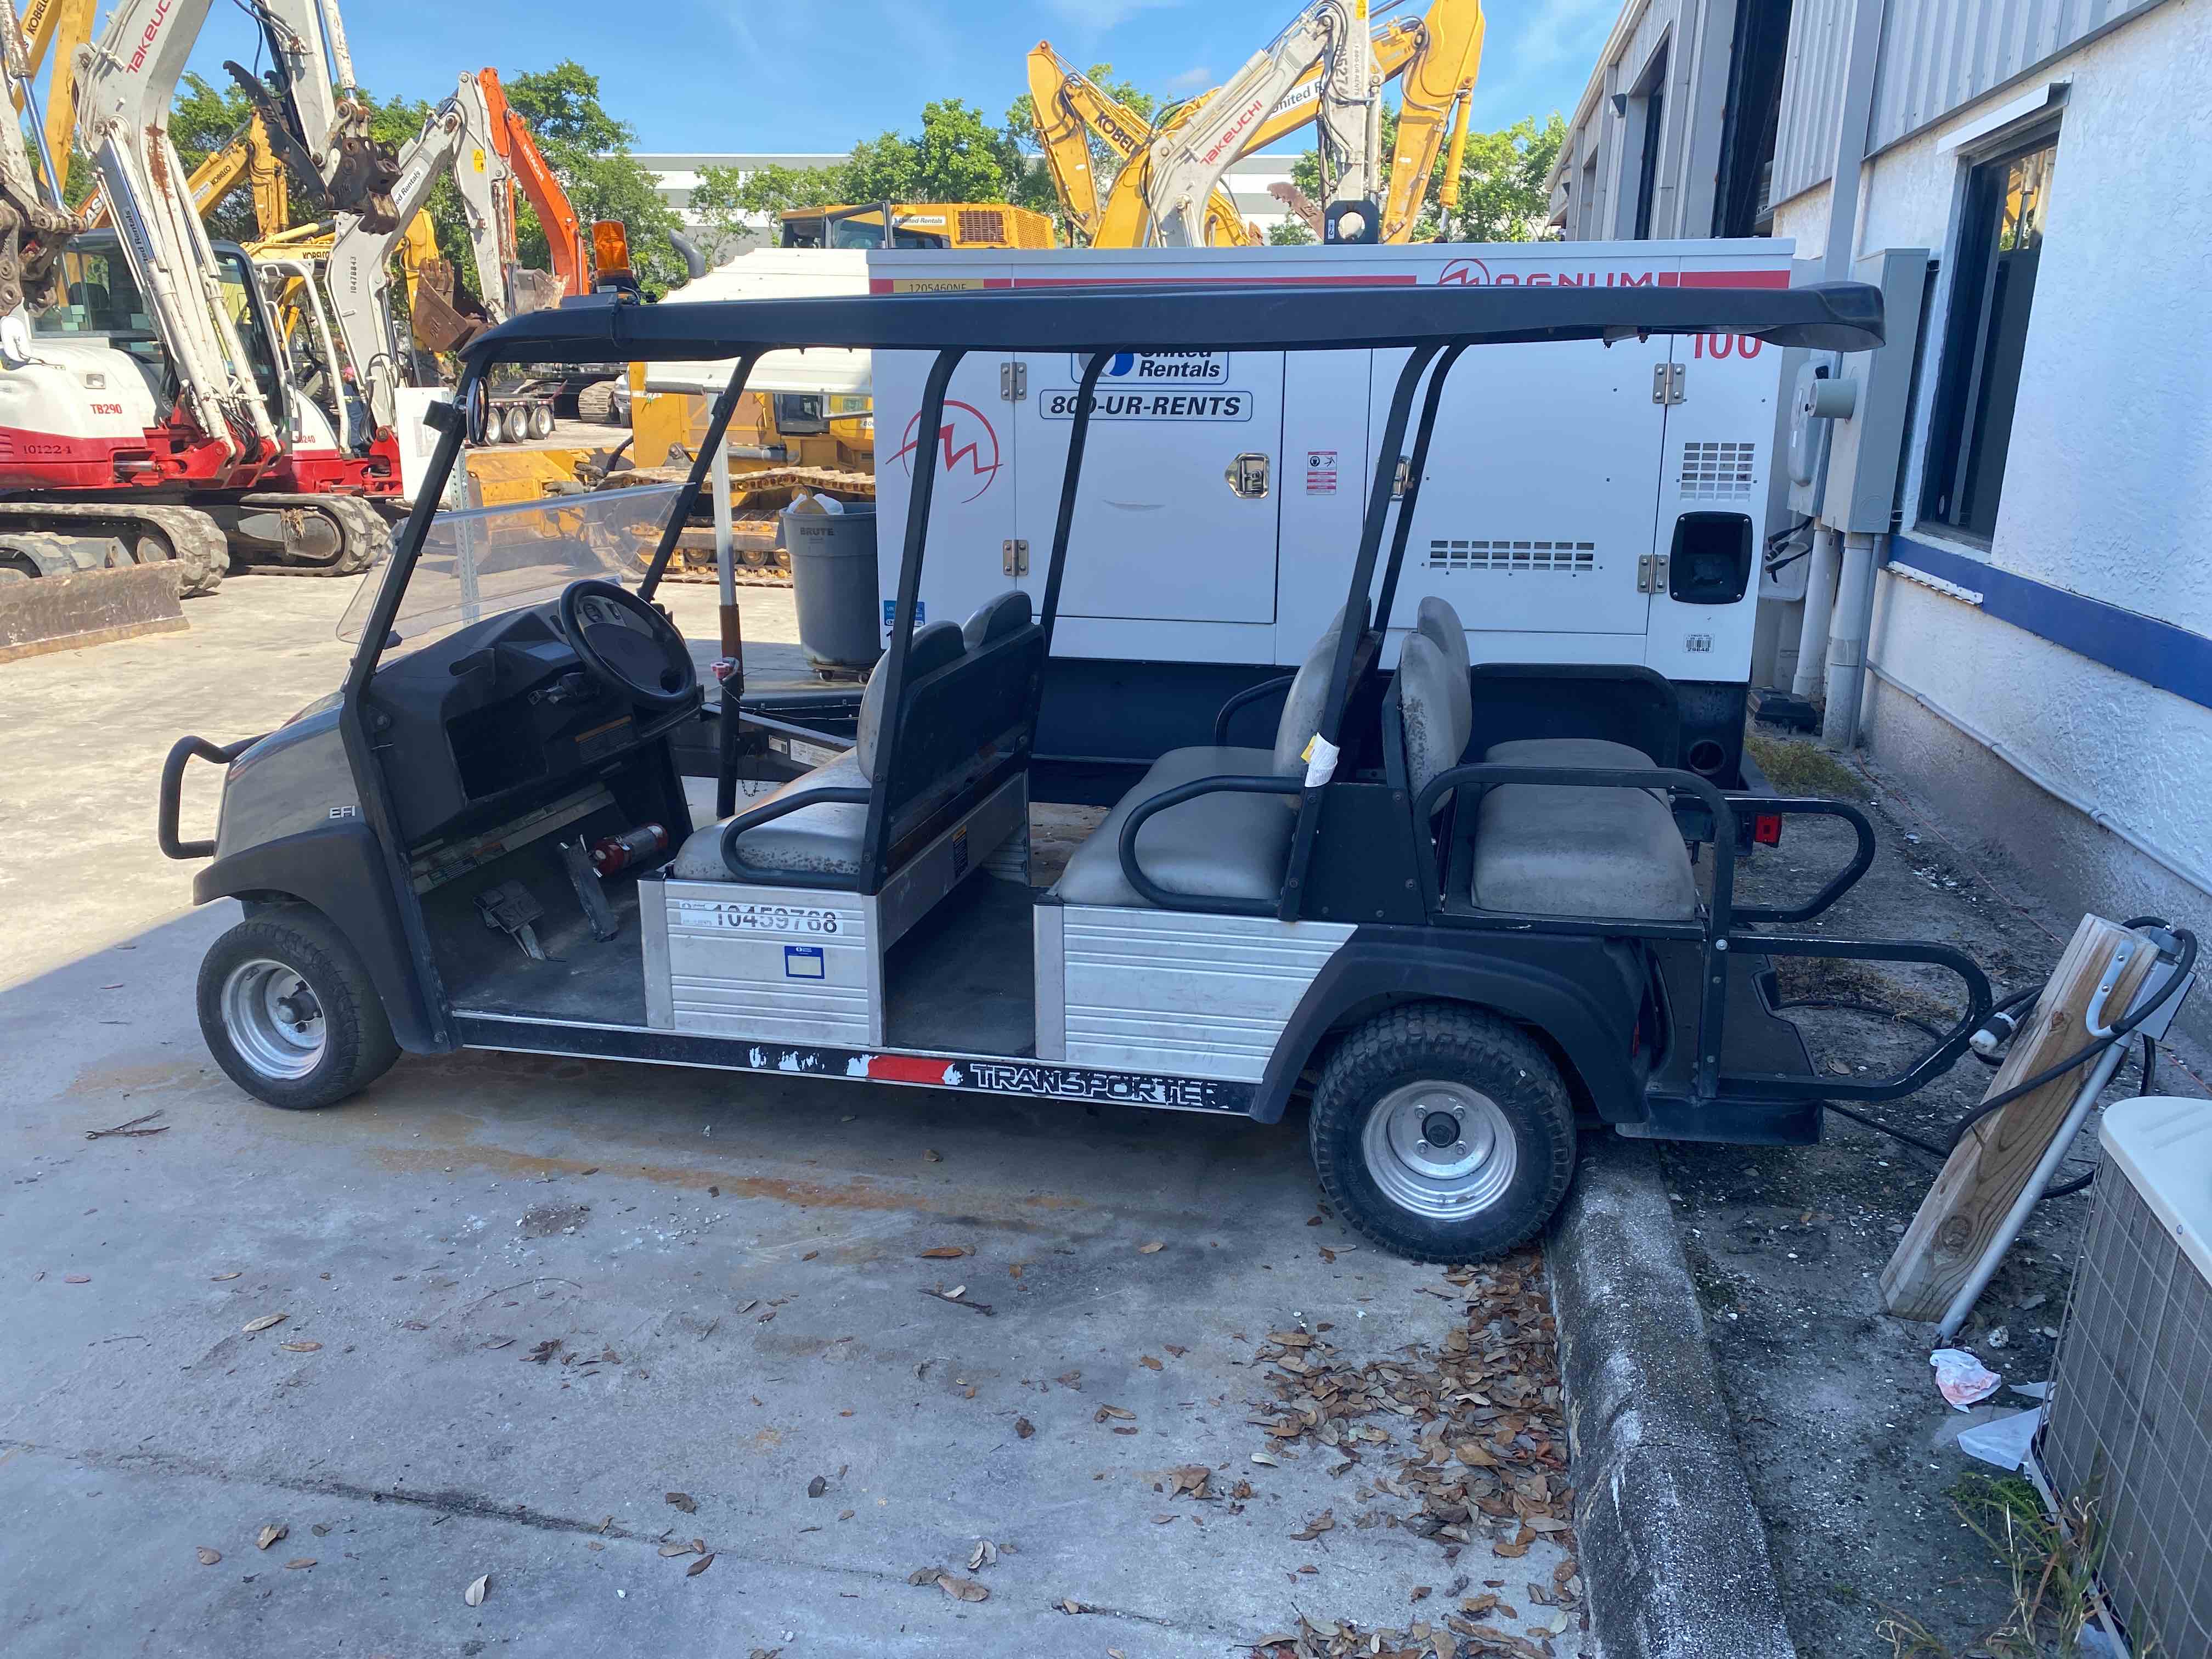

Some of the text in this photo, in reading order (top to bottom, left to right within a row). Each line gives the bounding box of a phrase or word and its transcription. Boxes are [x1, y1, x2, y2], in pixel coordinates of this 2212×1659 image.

[26, 0, 49, 35] KOBEL
[523, 143, 544, 182] HITACHI
[401, 171, 420, 195] Rentals
[1139, 360, 1220, 377] Rentals
[90, 404, 122, 414] TB290
[800, 527, 834, 536] BRUTE
[329, 805, 356, 819] EFI
